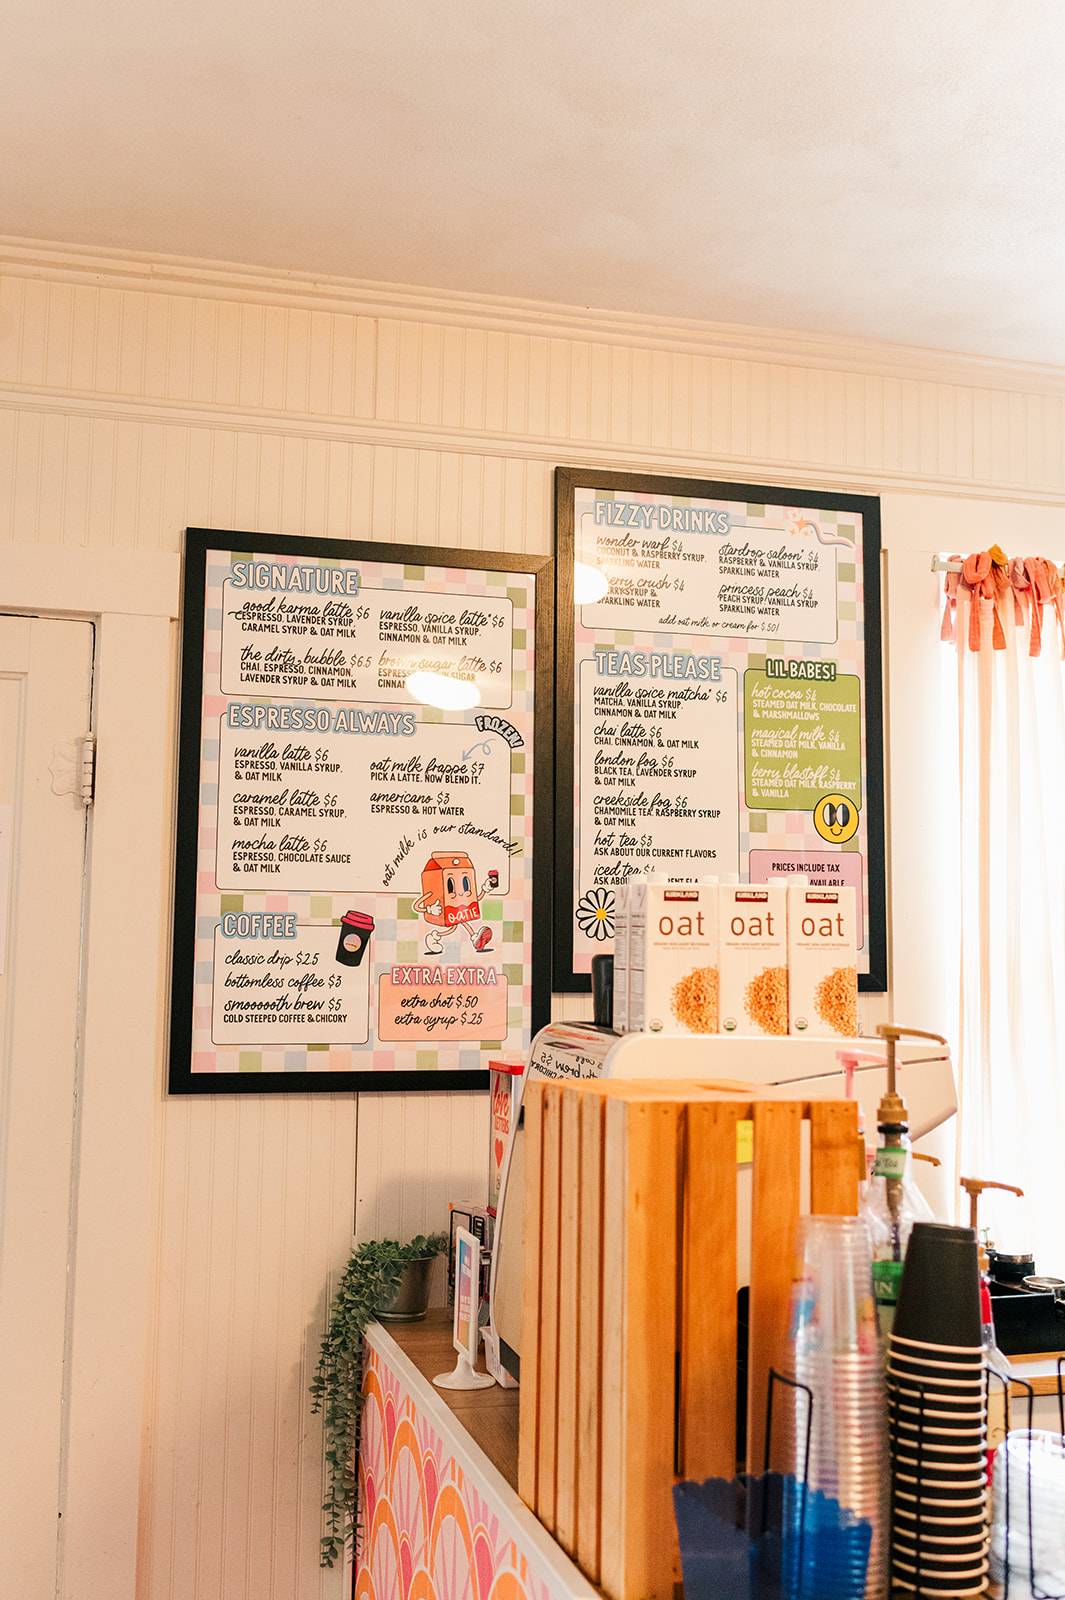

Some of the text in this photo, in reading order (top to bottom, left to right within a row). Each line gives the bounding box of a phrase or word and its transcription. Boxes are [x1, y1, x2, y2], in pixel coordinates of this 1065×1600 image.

[595, 502, 730, 535] FIZZY DRINKS
[596, 533, 640, 548] wonder
[641, 550, 681, 561] RASPBERRY
[718, 542, 766, 558] stardrop
[638, 560, 660, 569] WATER
[719, 556, 757, 567] RASPBERRY
[231, 562, 359, 596] SIGNATURE
[719, 566, 780, 579] SPARKLING WATER
[637, 574, 672, 589] crush
[718, 584, 800, 600] princess peach
[719, 594, 741, 603] PEACH
[229, 597, 354, 620] good latte
[637, 598, 661, 608] WATER
[720, 604, 780, 617] SPARKLING WATER
[286, 615, 326, 625] LAVENDER
[379, 606, 456, 626] vanilla spice
[658, 614, 677, 625] add
[678, 617, 690, 626] oat
[722, 622, 746, 630] cream
[746, 620, 759, 633] for
[242, 622, 280, 633] CARAMEL
[422, 624, 453, 634] VANILLA
[379, 632, 421, 643] CINNAMON
[241, 644, 262, 661] the
[265, 646, 301, 666] dirty
[304, 648, 347, 666] bubble
[350, 654, 373, 668] $6.5
[595, 652, 721, 681] TEAS PLEASE
[767, 660, 836, 680] LIL BABES!
[240, 673, 357, 688] LAVENDER SYRUP OAT MILK
[594, 682, 665, 699] vanilla spice
[752, 682, 802, 700] hot cocoa
[229, 705, 416, 736] ESPRESSO ALWAYS
[594, 708, 657, 719] CINNAMON OAT
[475, 715, 525, 749] FROZEN!
[594, 720, 619, 736] chai
[234, 742, 279, 760] vanilla
[682, 740, 699, 749] MILK
[370, 756, 485, 778] oat milk frappe $7
[594, 750, 659, 769] london fog
[245, 772, 260, 781] OAT
[370, 772, 481, 785] PICK A NOW BLEND IT.
[594, 766, 672, 778] BLACK LAVENDER
[752, 762, 781, 780] berry
[232, 789, 338, 807] caramel $6
[370, 790, 450, 805] americano $3
[593, 790, 672, 811] creekside fog
[278, 807, 317, 817] CARAMEL
[371, 804, 465, 816] ESPRESSO HOT WATER
[594, 806, 721, 819] CHAMOMILE RASPBERRY SYRUP
[261, 818, 281, 828] MILK
[618, 818, 636, 827] MILK
[232, 833, 277, 850] mocha
[594, 830, 653, 848] hot tea $3
[278, 853, 351, 864] CHOCOLATE SAUCE
[382, 821, 524, 887] oat milk is our standard!
[594, 848, 717, 858] ASK ABOUT OUR CURRENT FLAVORS
[244, 864, 259, 873] OAT
[594, 861, 622, 876] iced
[772, 862, 825, 873] PRICES INCLUDE
[223, 913, 296, 938] COFFEE
[658, 912, 705, 937] oat
[731, 912, 775, 937] oat
[802, 913, 845, 937] oat
[224, 950, 266, 965] classic
[267, 950, 293, 970] drip
[224, 972, 342, 992] bottomless coffee $3
[392, 967, 497, 986] EXTRA EXTRA
[294, 993, 325, 1011] brew
[328, 997, 342, 1012] $5
[400, 992, 479, 1009] extra shot $.50
[224, 1014, 348, 1023] COLD STEEPED COFFEE CHICORY
[394, 1012, 422, 1025] extra
[424, 1015, 458, 1032] syrup
